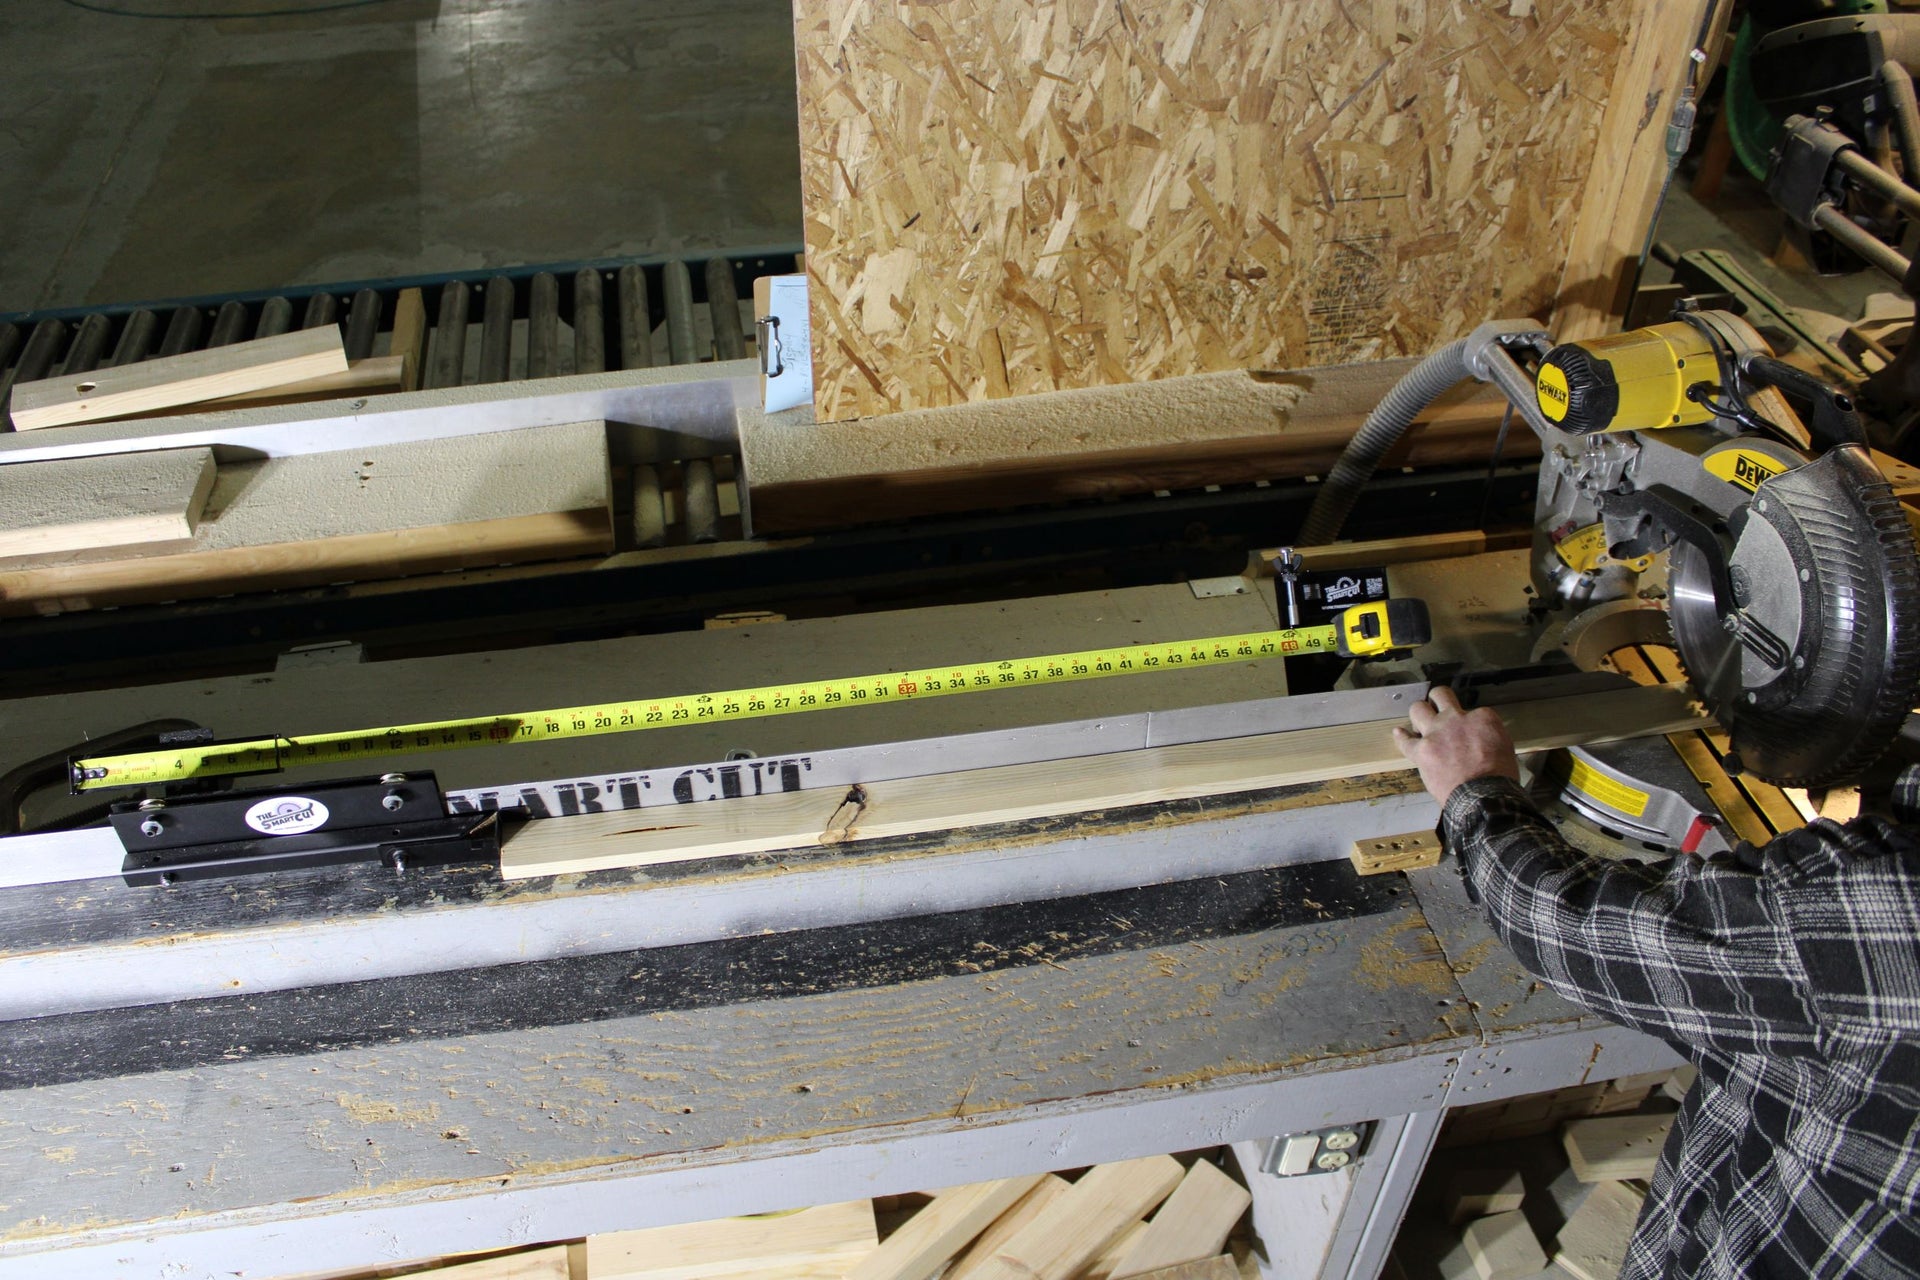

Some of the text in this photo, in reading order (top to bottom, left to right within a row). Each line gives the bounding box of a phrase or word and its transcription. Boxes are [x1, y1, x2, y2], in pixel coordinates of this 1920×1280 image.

[174, 760, 182, 769] 4
[307, 746, 315, 755] 9
[338, 742, 349, 751] 10
[364, 740, 373, 749] 11
[390, 740, 403, 749] 12
[417, 737, 429, 746] 13
[442, 735, 455, 744] 14
[469, 732, 482, 741] 15
[520, 726, 533, 735] 17
[546, 723, 559, 733] 18
[572, 720, 585, 730] 19
[595, 718, 611, 728] 20
[621, 715, 634, 725] 21
[646, 712, 663, 722] 22
[672, 710, 689, 719] 23
[697, 707, 714, 717] 24
[723, 704, 740, 714] 25
[749, 701, 765, 711] 26
[774, 698, 790, 708] 27
[800, 696, 816, 705] 28
[825, 692, 841, 702] 29
[850, 690, 866, 699] 30
[875, 687, 888, 697] 31
[899, 684, 916, 693] 32
[925, 681, 941, 691] 33
[950, 678, 966, 688] 34
[974, 676, 990, 685] 35
[999, 673, 1015, 682] 36
[1023, 670, 1039, 680] 37
[1047, 667, 1064, 677] 38
[1072, 665, 1088, 674] 39
[1096, 662, 1112, 672] 40
[1119, 660, 1132, 669] 41
[1144, 657, 1159, 666] 42
[1167, 654, 1183, 664] 43
[1190, 652, 1206, 661] 44
[1214, 649, 1229, 658] 45
[1237, 646, 1252, 656] 46
[1260, 644, 1275, 653] 47
[1283, 641, 1298, 650] 48
[1306, 638, 1320, 647] 49
[673, 757, 812, 804] CUT
[256, 811, 275, 821] THE
